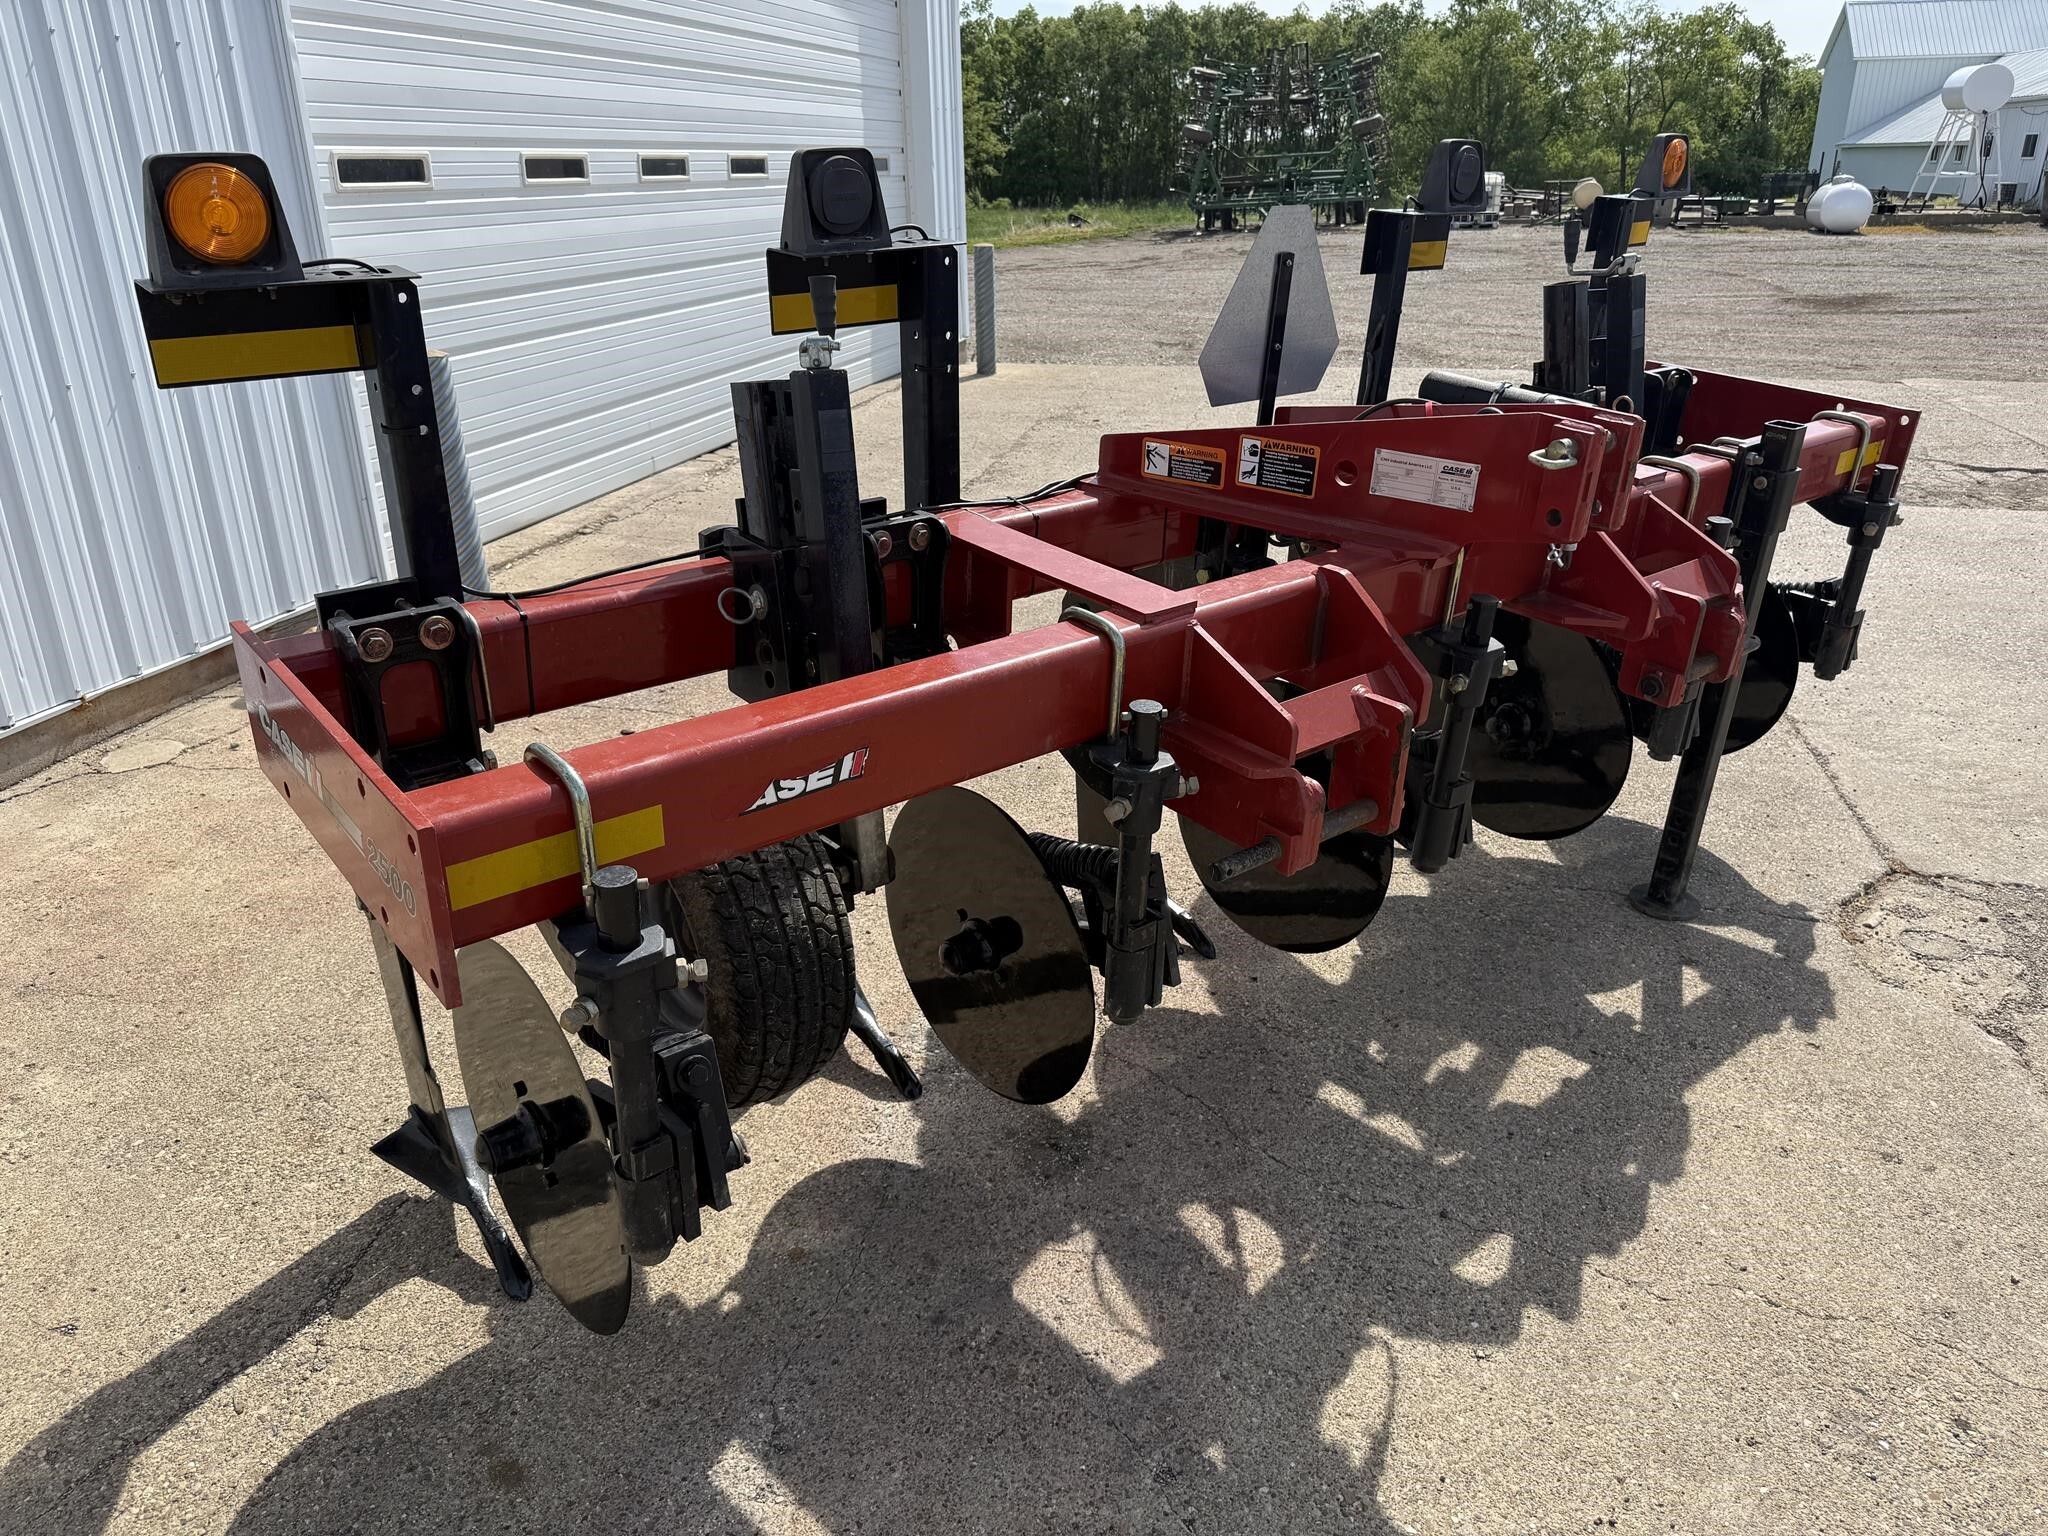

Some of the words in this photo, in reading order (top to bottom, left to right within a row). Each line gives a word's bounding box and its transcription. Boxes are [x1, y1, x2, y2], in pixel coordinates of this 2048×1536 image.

[1187, 448, 1218, 459] WARNING
[1272, 441, 1315, 455] WARNING
[1442, 465, 1465, 474] CASE
[258, 704, 307, 780] CASE
[366, 837, 417, 919] 2500
